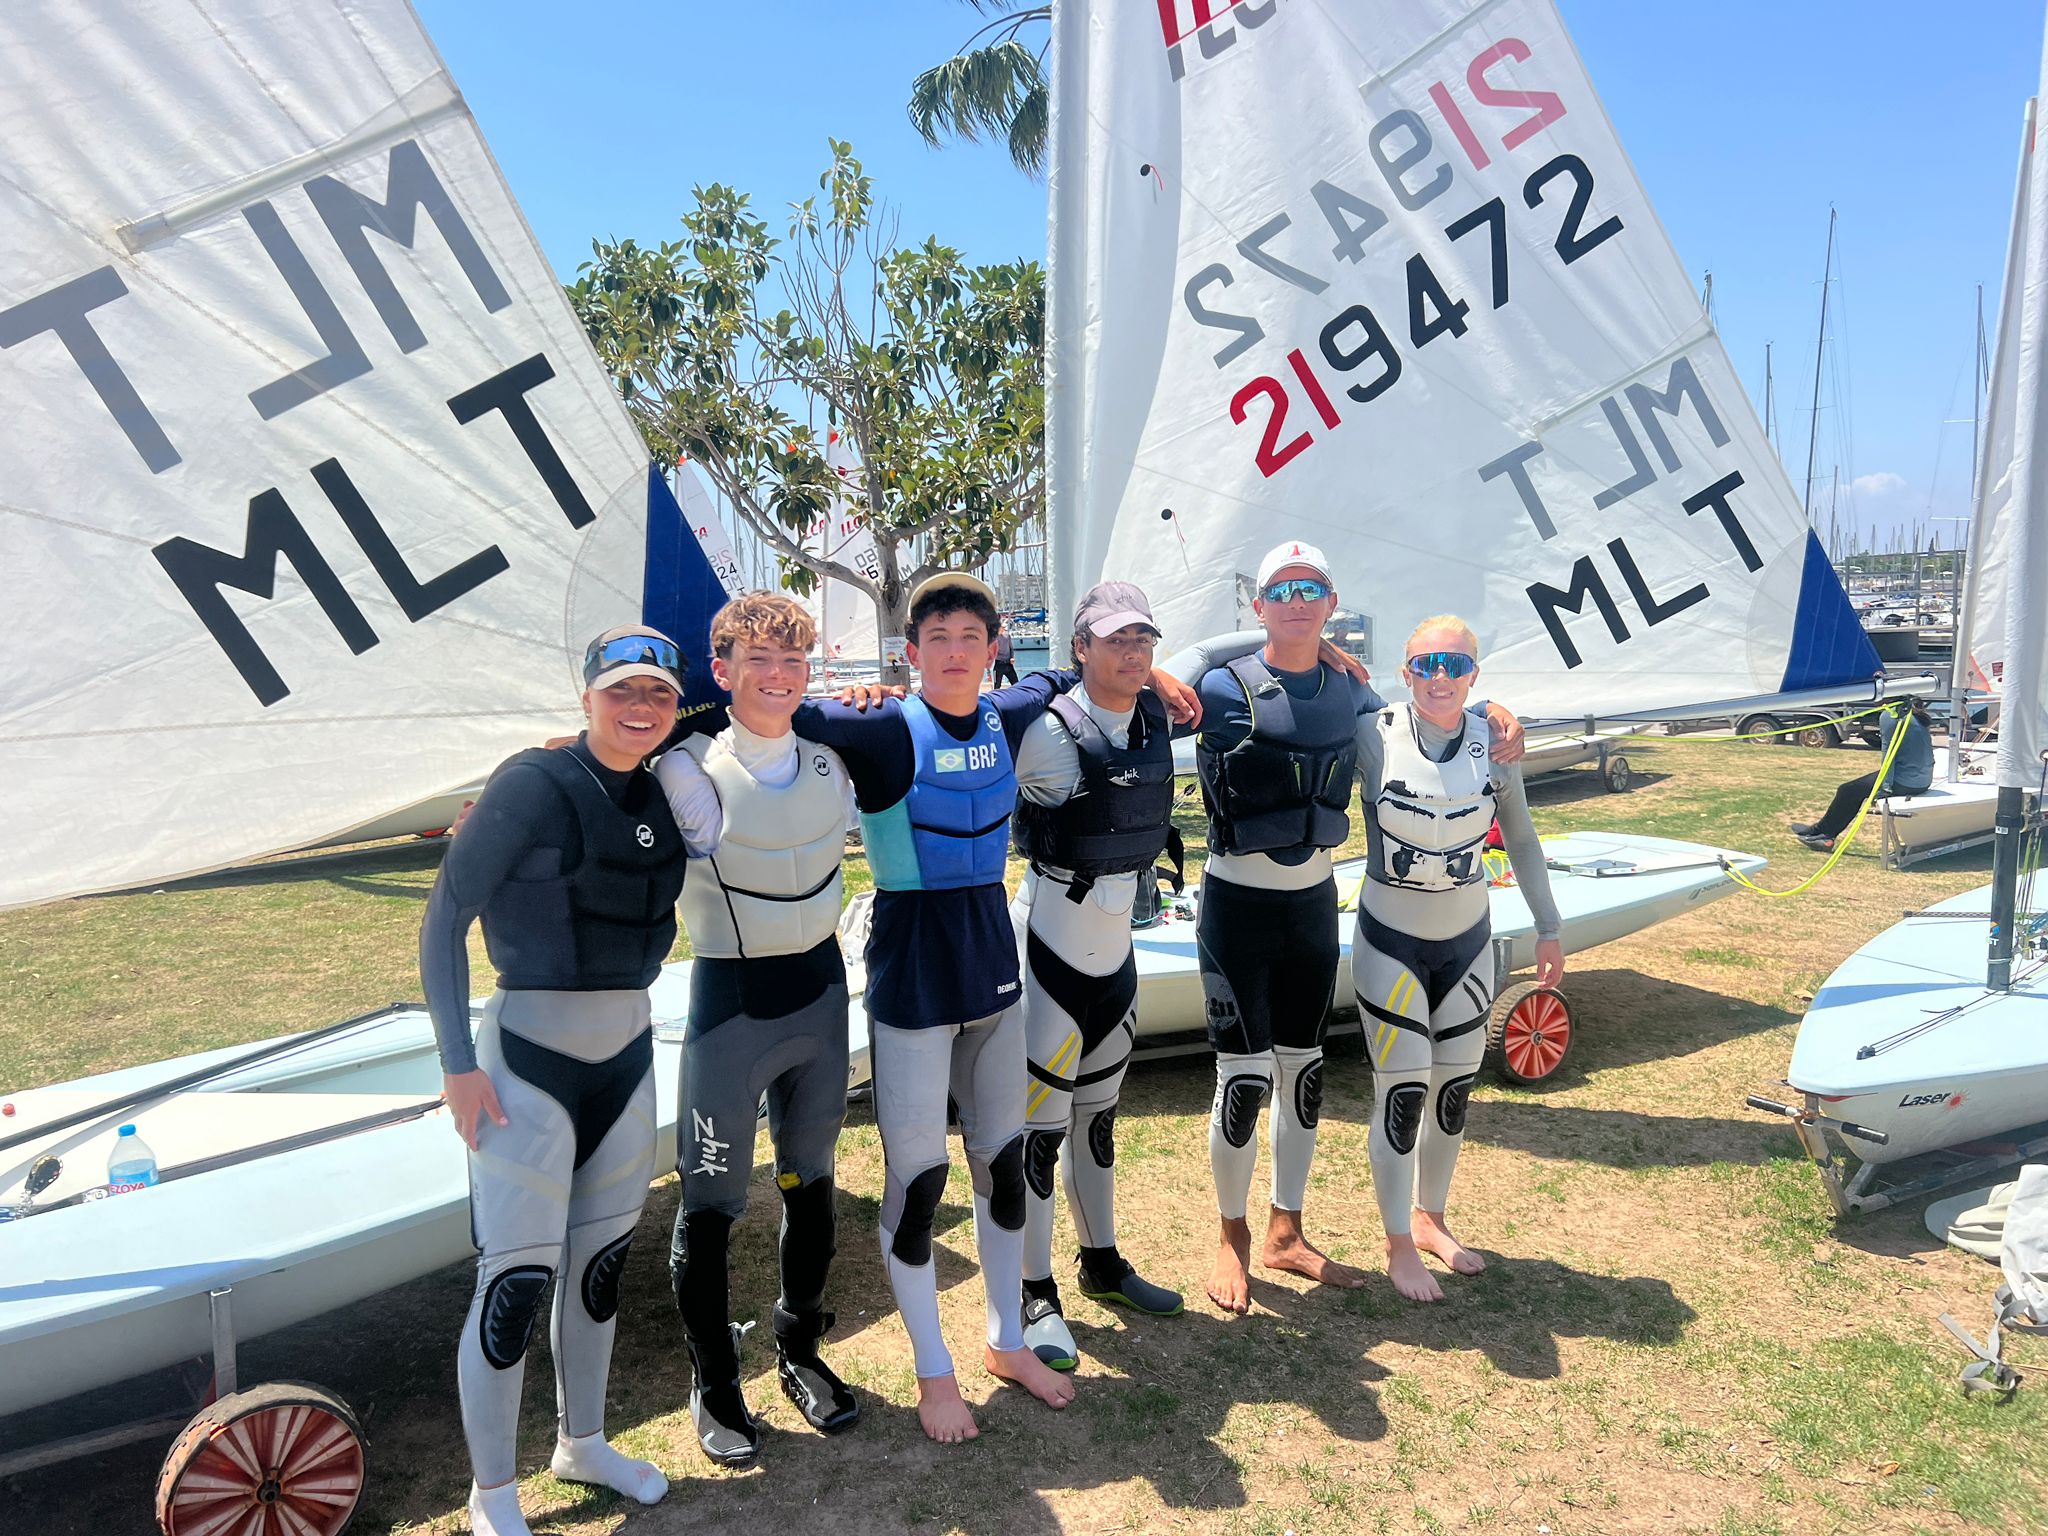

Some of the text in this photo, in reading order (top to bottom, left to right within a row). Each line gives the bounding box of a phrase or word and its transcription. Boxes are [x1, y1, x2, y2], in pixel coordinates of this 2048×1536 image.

[1229, 154, 1624, 478] 219472
[152, 352, 596, 707] MLT
[1525, 470, 1764, 669] MLT
[968, 742, 998, 770] BRA
[1898, 1092, 1952, 1108] Laser
